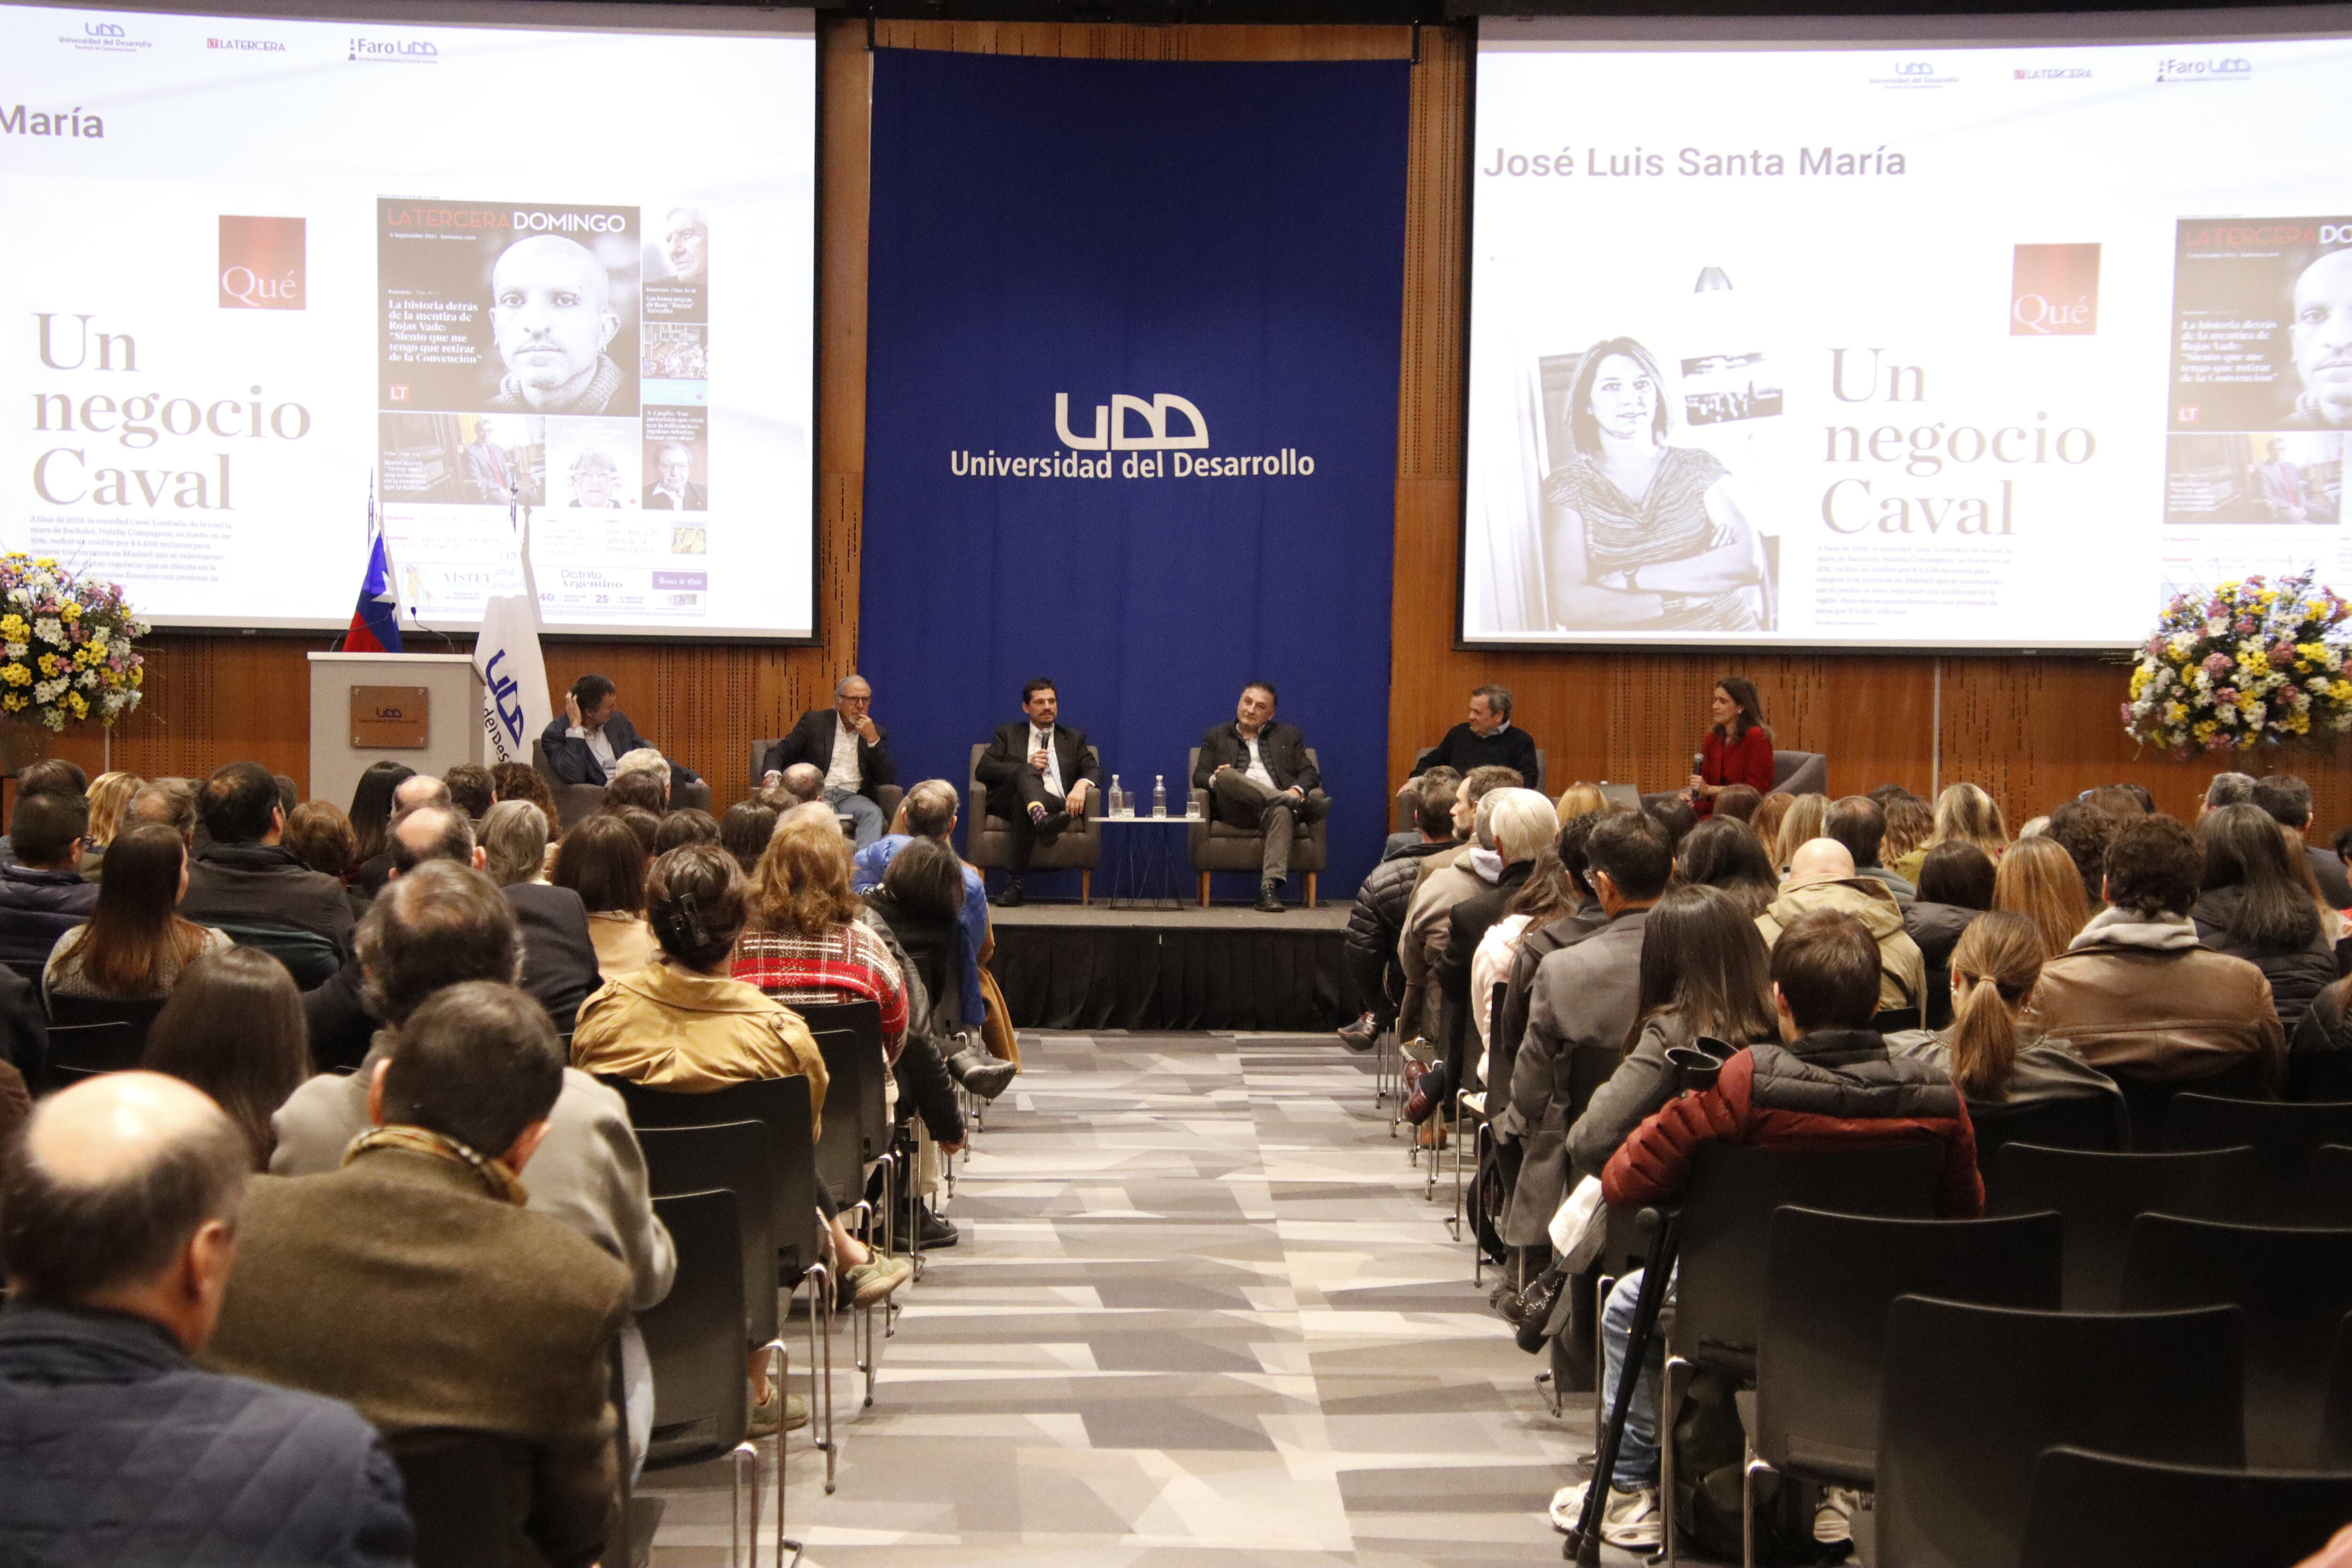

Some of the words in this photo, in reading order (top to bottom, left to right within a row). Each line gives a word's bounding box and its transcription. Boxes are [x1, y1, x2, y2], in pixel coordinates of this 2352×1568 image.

[59, 36, 101, 46] Universidad
[116, 40, 152, 48] Desarrollo
[220, 40, 286, 51] LATERCERA
[358, 38, 394, 54] Faro
[2167, 59, 2204, 74] Faro
[2027, 68, 2093, 79] LATERCERA
[0, 105, 105, 139] María
[1483, 147, 1575, 177] José
[1588, 146, 1664, 177] Luis
[1678, 147, 1784, 177] Santa
[1799, 145, 1906, 176] María
[387, 208, 512, 229] LATERCERA
[513, 211, 626, 233] DOMINGO
[2185, 225, 2318, 246] LATERCERA
[223, 266, 297, 308] Qué
[389, 300, 402, 309] La
[404, 300, 444, 310] historia
[446, 301, 478, 311] detrás
[389, 310, 402, 320] de
[404, 310, 413, 320] la
[416, 312, 457, 322] mentira
[459, 312, 472, 322] de
[2014, 293, 2089, 333] Qué
[389, 321, 417, 333] Rojas
[419, 322, 446, 332] Vade:
[2181, 320, 2195, 330] La
[2198, 320, 2240, 330] historia
[429, 334, 448, 344] que
[451, 334, 467, 343] me
[2181, 330, 2195, 341] de
[2198, 330, 2208, 341] la
[2211, 330, 2254, 341] mentira
[2256, 330, 2270, 340] de
[31, 313, 141, 372] Un
[389, 343, 418, 353] tengo
[420, 344, 439, 353] que
[442, 344, 475, 353] retirar
[389, 352, 402, 361] de
[404, 353, 413, 362] la
[1826, 347, 1928, 403] Un
[2180, 373, 2194, 382] de
[2195, 373, 2205, 382] la
[391, 386, 407, 400] LT
[31, 384, 311, 449] negocio
[2181, 407, 2199, 421] LT
[1055, 392, 1210, 451] UDD
[1822, 410, 2096, 478] negocio
[951, 450, 1112, 479] Universidad
[1122, 450, 1164, 479] del
[1174, 448, 1315, 478] Desarrollo
[34, 448, 235, 510] Caval
[1821, 478, 2016, 535] Caval
[153, 519, 188, 528] Limitada,
[63, 527, 97, 535] Bachelet,
[127, 529, 174, 539] Compagnon,
[107, 561, 143, 570] regulador
[170, 562, 196, 571] discute
[125, 571, 159, 580] firmaron
[176, 574, 209, 582] promesa
[210, 574, 219, 582] de
[561, 569, 602, 580] Distrito
[562, 579, 623, 589] Argentino
[539, 593, 555, 602] 40
[594, 594, 610, 604] 25
